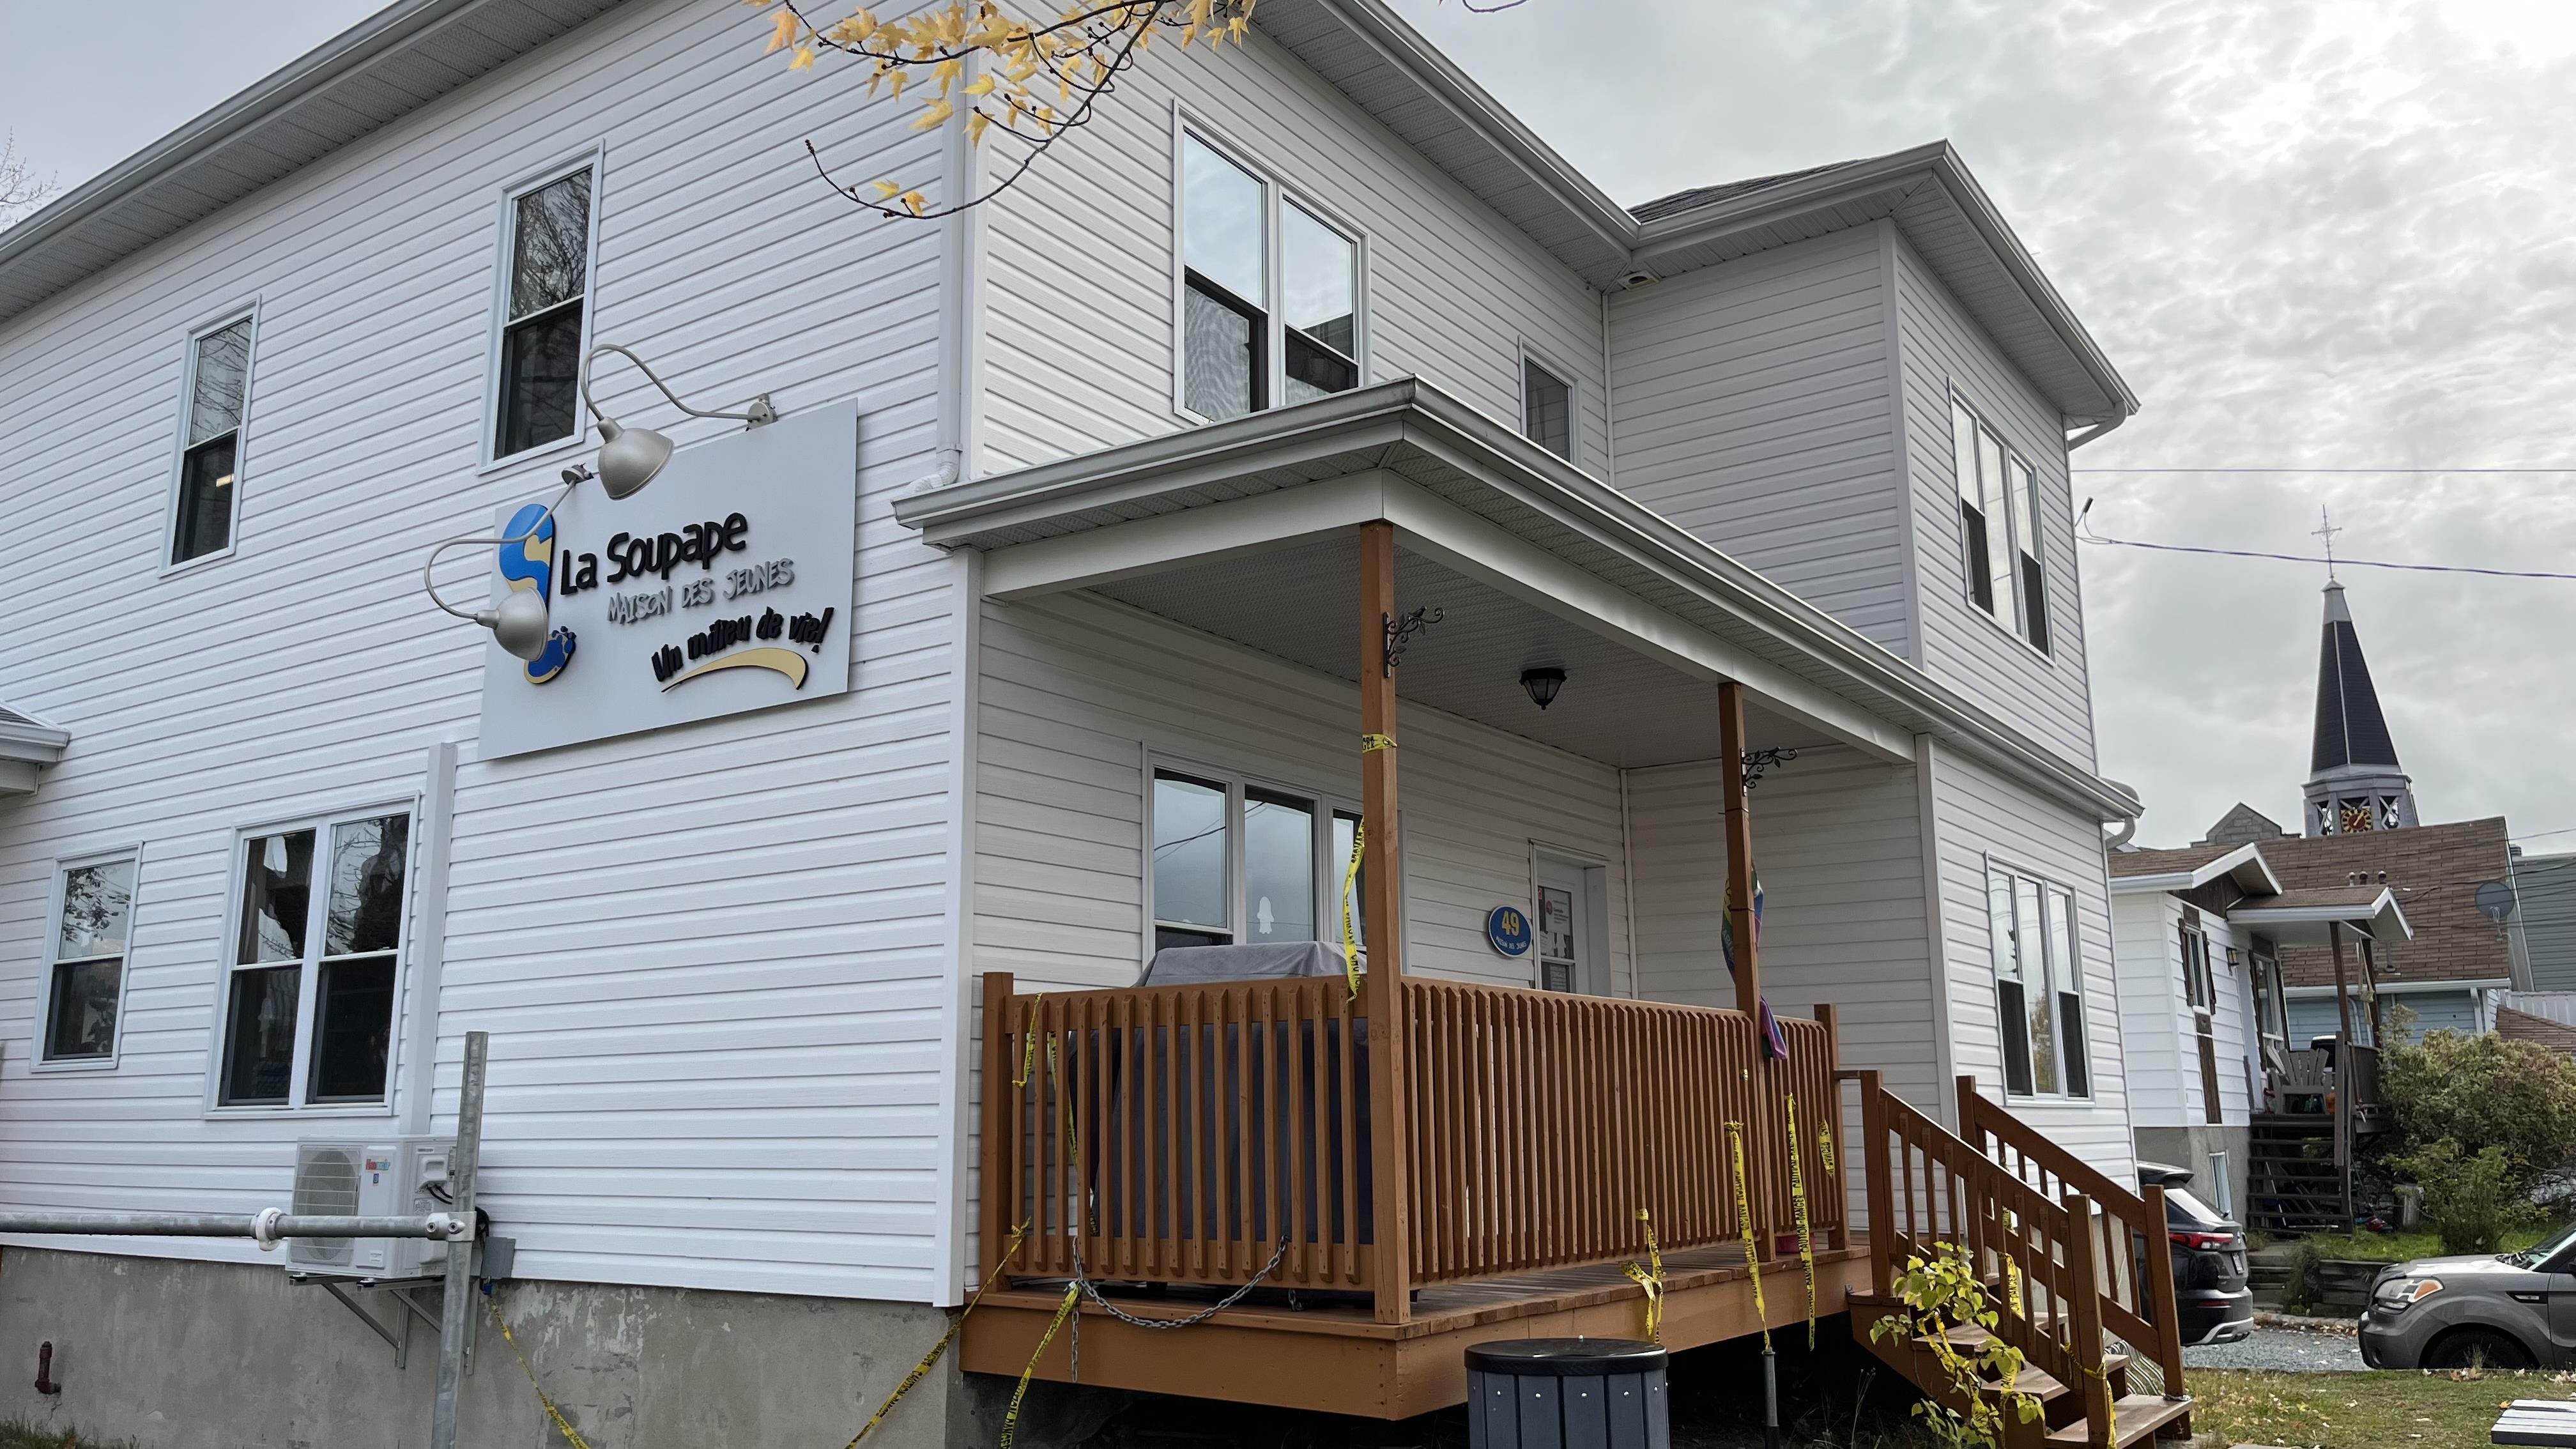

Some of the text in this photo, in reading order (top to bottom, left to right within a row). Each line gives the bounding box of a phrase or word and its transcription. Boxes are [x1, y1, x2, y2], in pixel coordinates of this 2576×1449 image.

[560, 512, 747, 595] La Soupape
[607, 558, 795, 625] MAISON DES JEUNES
[651, 607, 834, 682] Un milieu de vie!
[1501, 910, 1519, 936] 49
